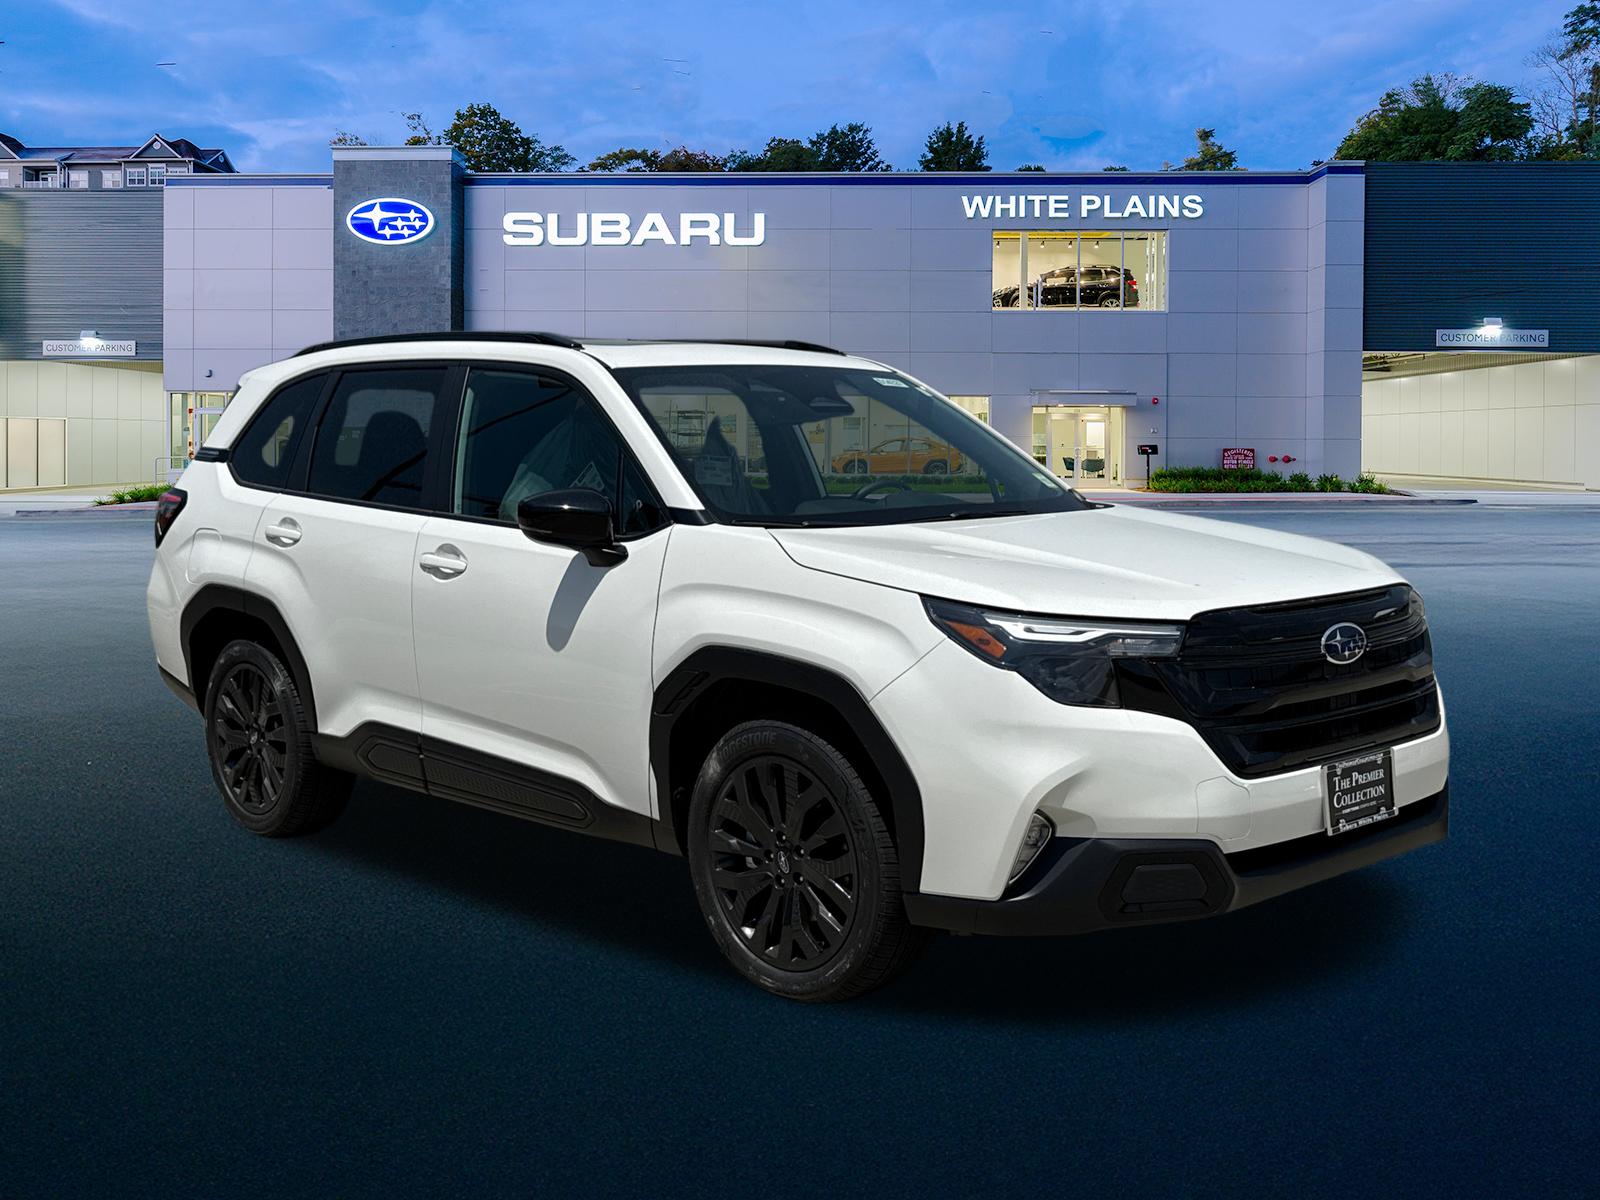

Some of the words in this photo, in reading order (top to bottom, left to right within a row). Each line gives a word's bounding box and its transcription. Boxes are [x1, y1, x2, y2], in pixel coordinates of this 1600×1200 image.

[962, 195, 1069, 218] WHITE
[1080, 195, 1204, 218] PLAINS
[503, 212, 765, 246] SUBARU
[45, 344, 92, 352] CUSTOMER
[95, 344, 133, 352] PARKING
[1440, 333, 1496, 343] CUSTOMER
[1500, 333, 1545, 343] PARKING
[1224, 449, 1253, 457] REGISTERED
[1333, 777, 1351, 791] THE
[1352, 769, 1384, 786] PREMIER
[1333, 785, 1385, 808] COLLECTION
